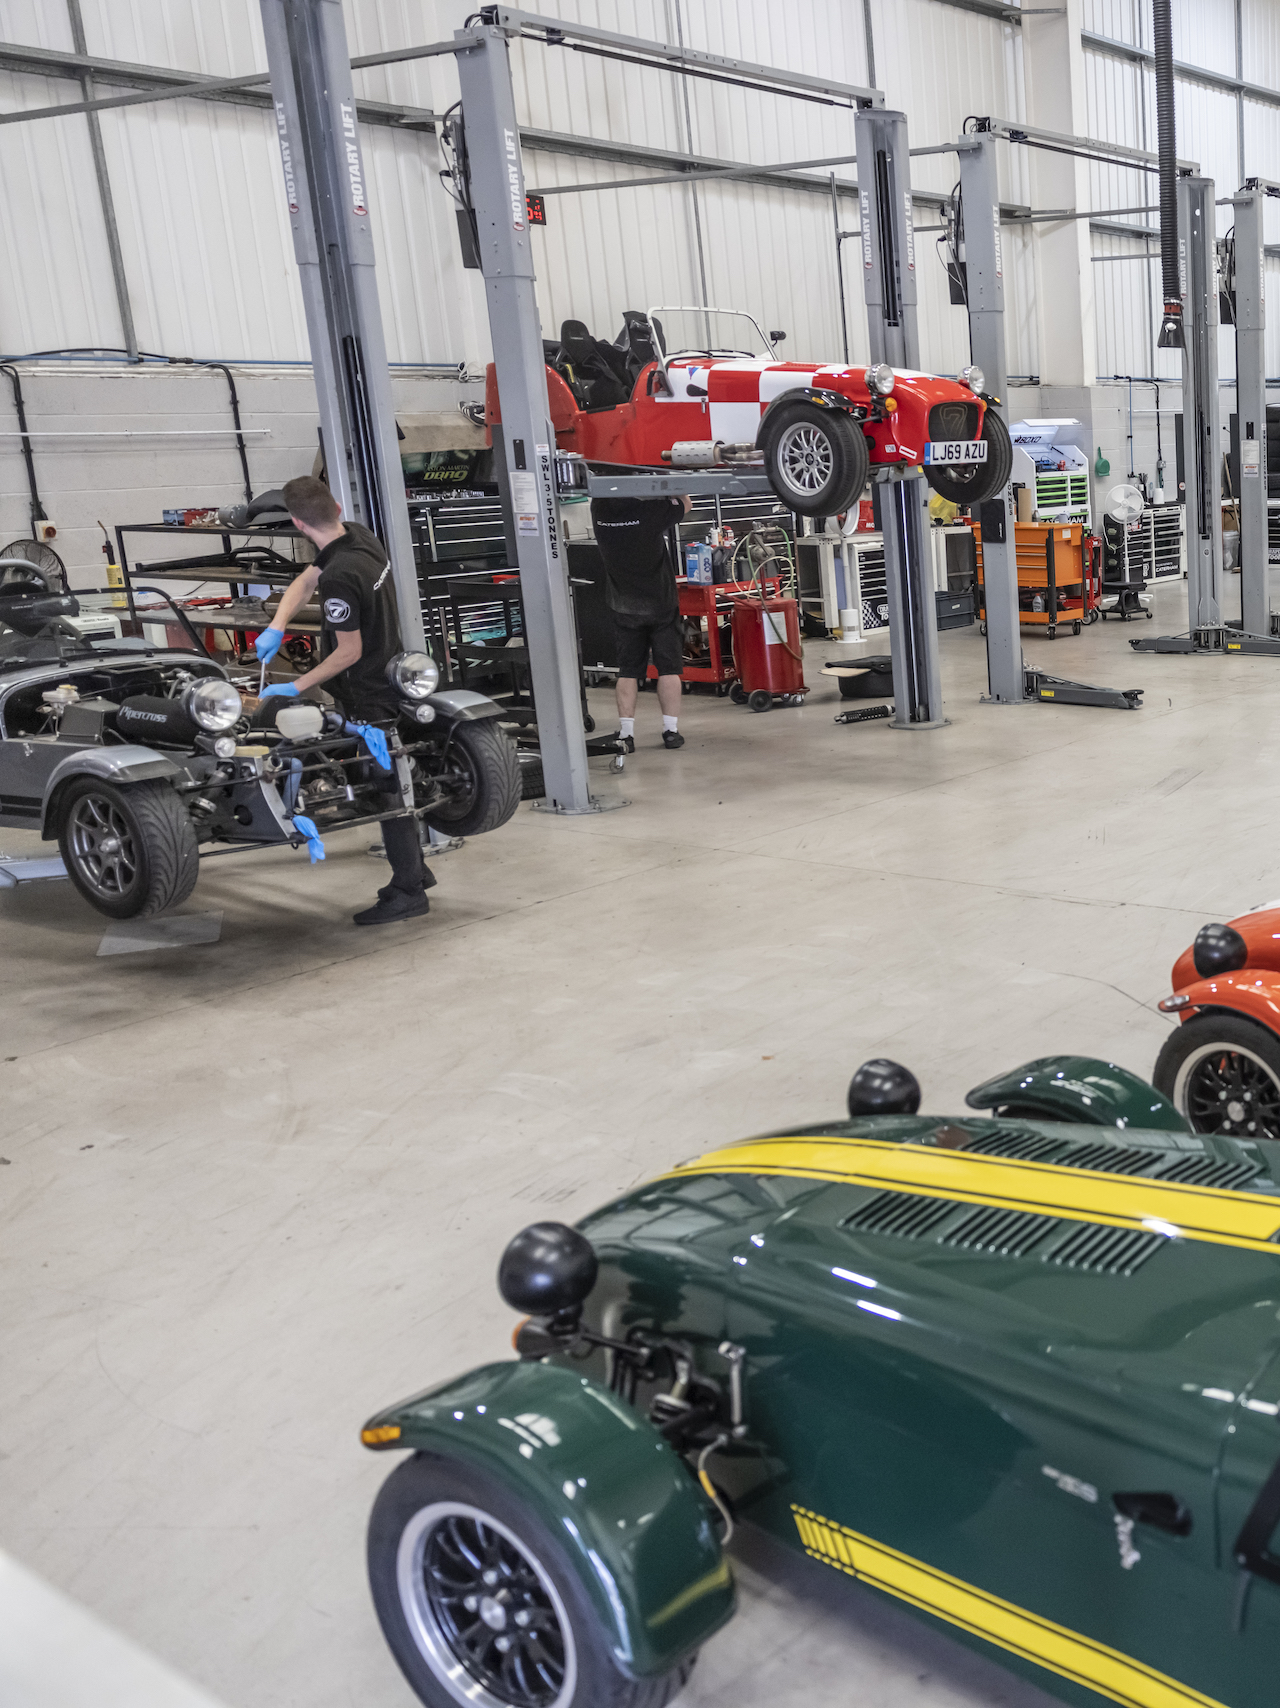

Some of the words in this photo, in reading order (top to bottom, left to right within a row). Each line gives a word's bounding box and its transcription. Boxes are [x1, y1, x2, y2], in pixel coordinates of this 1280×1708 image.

[275, 100, 287, 134] LIFT
[341, 103, 356, 138] LIFT
[504, 128, 516, 160] LIFT
[281, 140, 296, 204] ROTARY
[346, 142, 364, 206] ROTARY
[508, 163, 523, 222] ROTARY
[861, 190, 870, 214] LIFT
[862, 218, 872, 262] ROTARY
[906, 219, 914, 264] ROTARY
[932, 445, 961, 461] LJ69
[964, 443, 985, 459] AZU
[541, 455, 550, 481] SWL
[547, 508, 558, 559] TONNES
[119, 706, 168, 723] Pipercross
